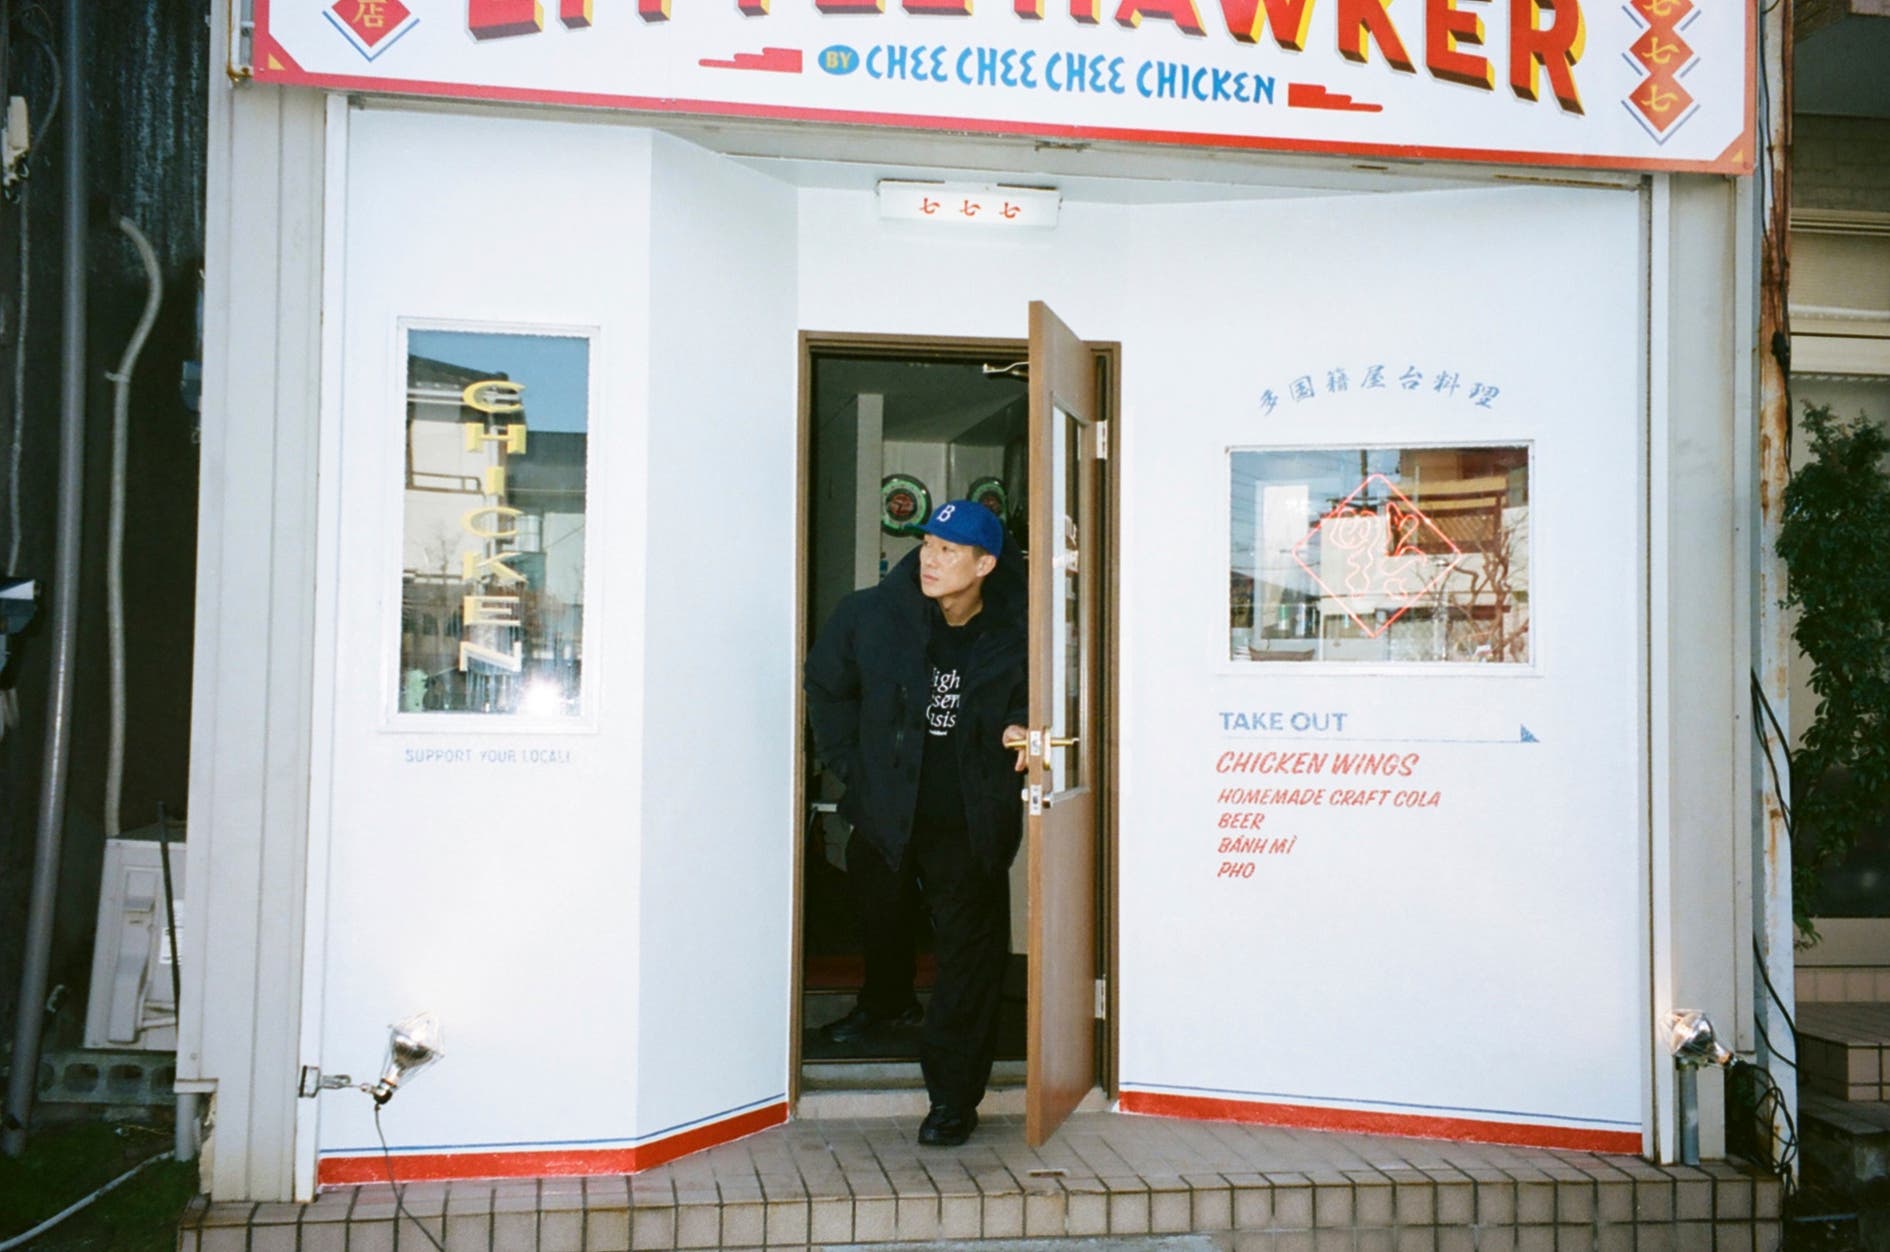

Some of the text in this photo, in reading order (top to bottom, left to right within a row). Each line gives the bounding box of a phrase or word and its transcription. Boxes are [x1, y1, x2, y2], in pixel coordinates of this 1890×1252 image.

[352, 0, 388, 28] 店
[825, 45, 1276, 105] BY CHEE CHEE CHEE CHICKEN
[1258, 364, 1501, 416] 多国籍屋台料理
[936, 504, 956, 522] B
[459, 379, 528, 672] CHICKEN
[932, 667, 961, 693] igh
[1219, 711, 1348, 732] TAKE OUT
[405, 748, 472, 764] SUPPORT
[480, 748, 517, 764] YOUR
[1216, 751, 1419, 777] CHICKEN WINGS
[1217, 788, 1442, 808] HOMEMADE CRAFT COLA
[1217, 812, 1265, 830] BEER
[1217, 861, 1256, 879] PHO
